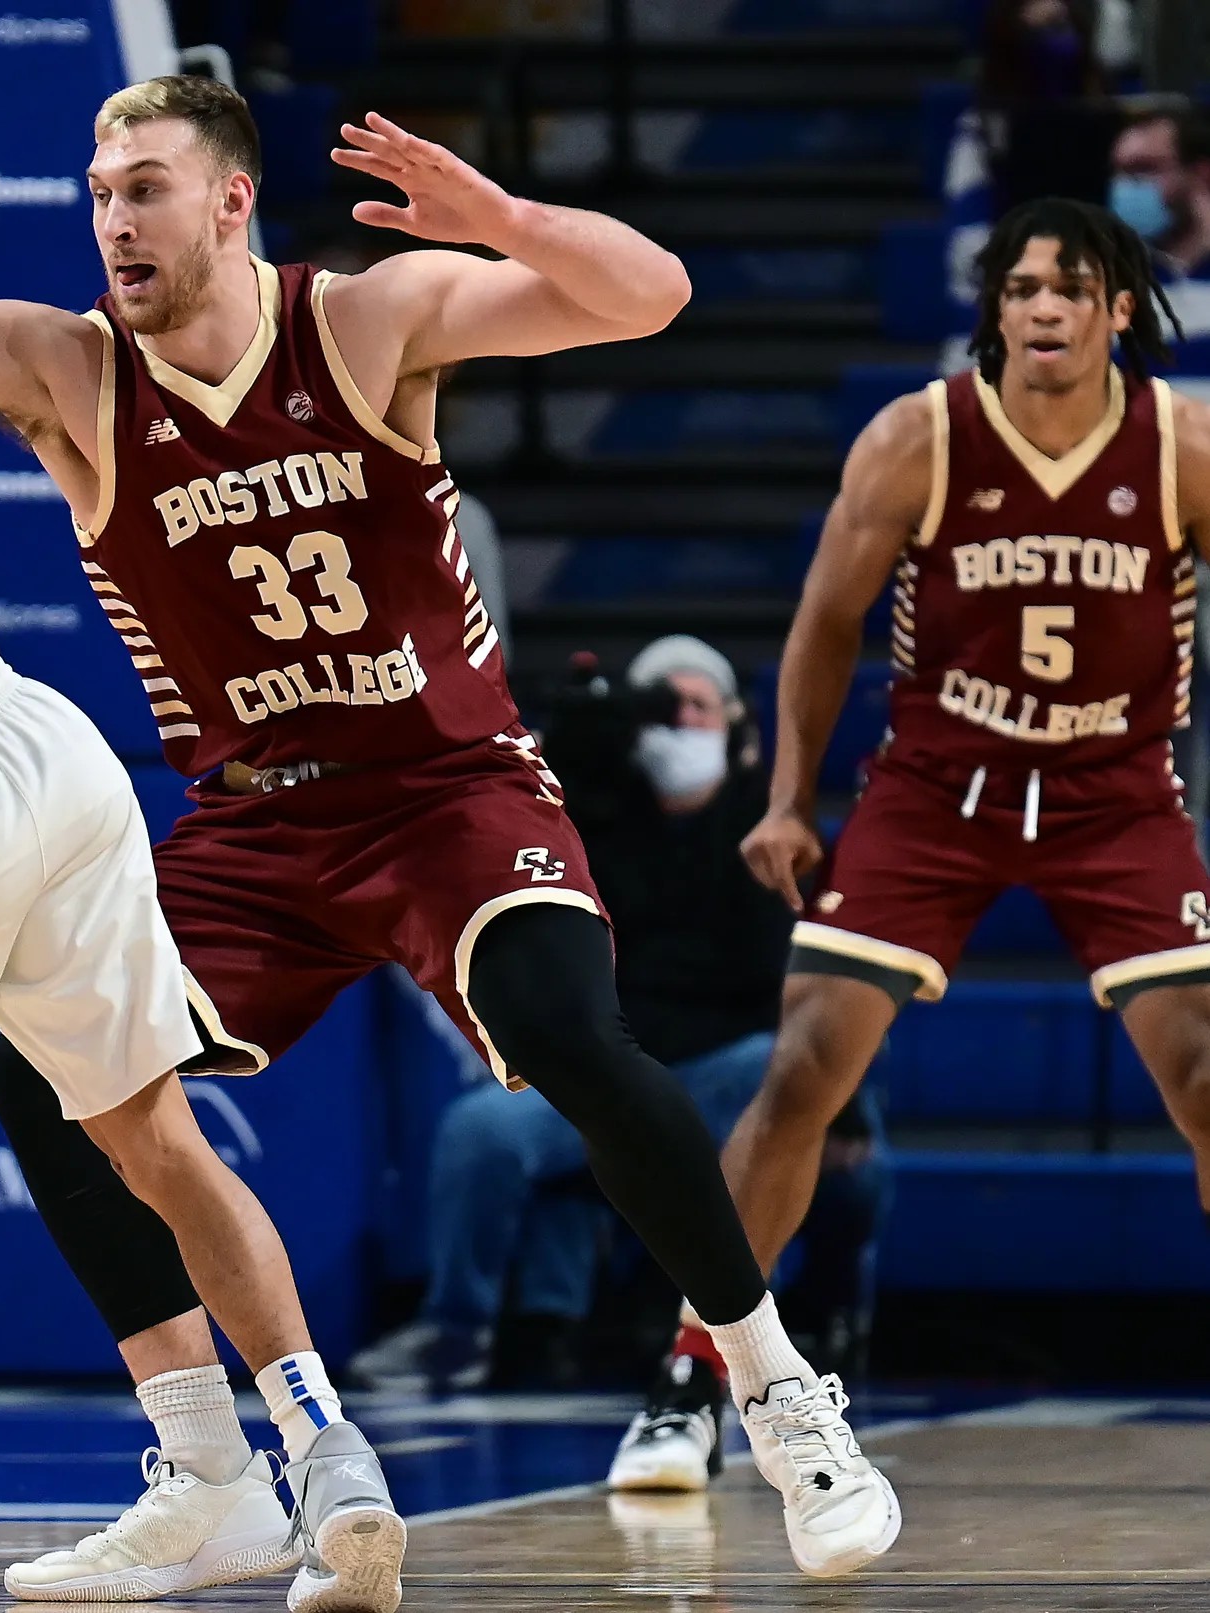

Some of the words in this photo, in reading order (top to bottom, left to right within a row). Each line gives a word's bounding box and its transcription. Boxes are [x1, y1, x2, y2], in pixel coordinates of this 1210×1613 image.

[153, 452, 368, 548] BOSTON
[228, 530, 369, 640] 33
[951, 535, 1151, 593] BOSTON
[225, 632, 428, 724] COLLEGE
[1020, 605, 1075, 684] 5
[939, 667, 1131, 744] COLLEGE
